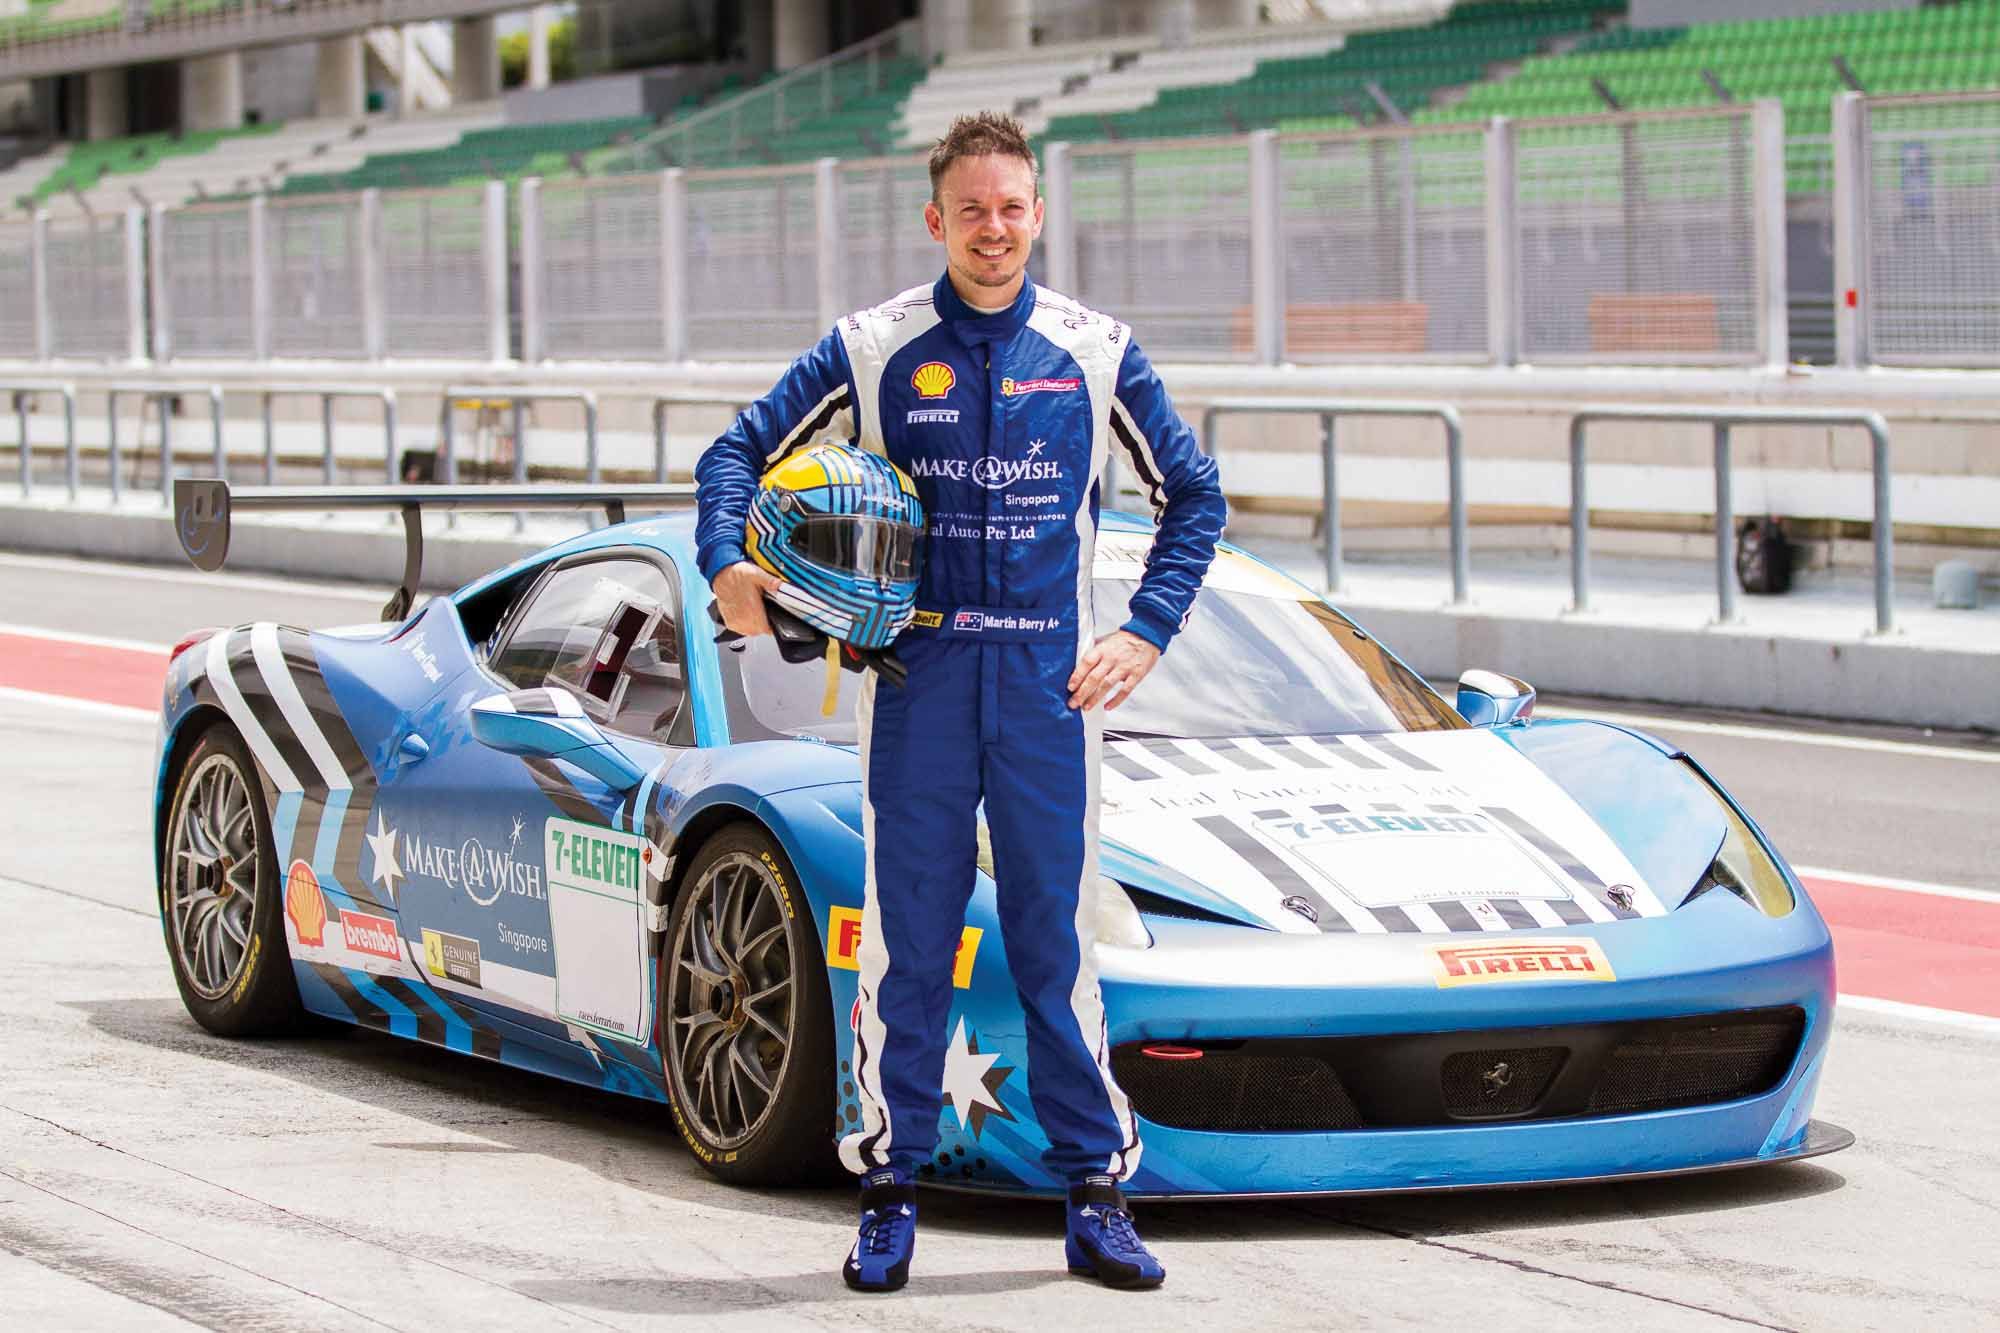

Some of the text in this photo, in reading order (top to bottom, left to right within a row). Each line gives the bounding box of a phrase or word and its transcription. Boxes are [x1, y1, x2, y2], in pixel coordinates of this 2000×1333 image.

[907, 410, 960, 424] PIRELLI
[1005, 494, 1060, 507] Singapore
[948, 524, 981, 538] Auto
[985, 526, 1007, 540] Pte
[1010, 525, 1036, 539] Ltd
[916, 612, 938, 625] belt
[984, 615, 1060, 631] Martin Berry A+
[344, 916, 397, 955] brembo
[498, 922, 548, 955] Singapore
[444, 945, 478, 963] GENUINE
[1437, 945, 1596, 977] PIRELLI
